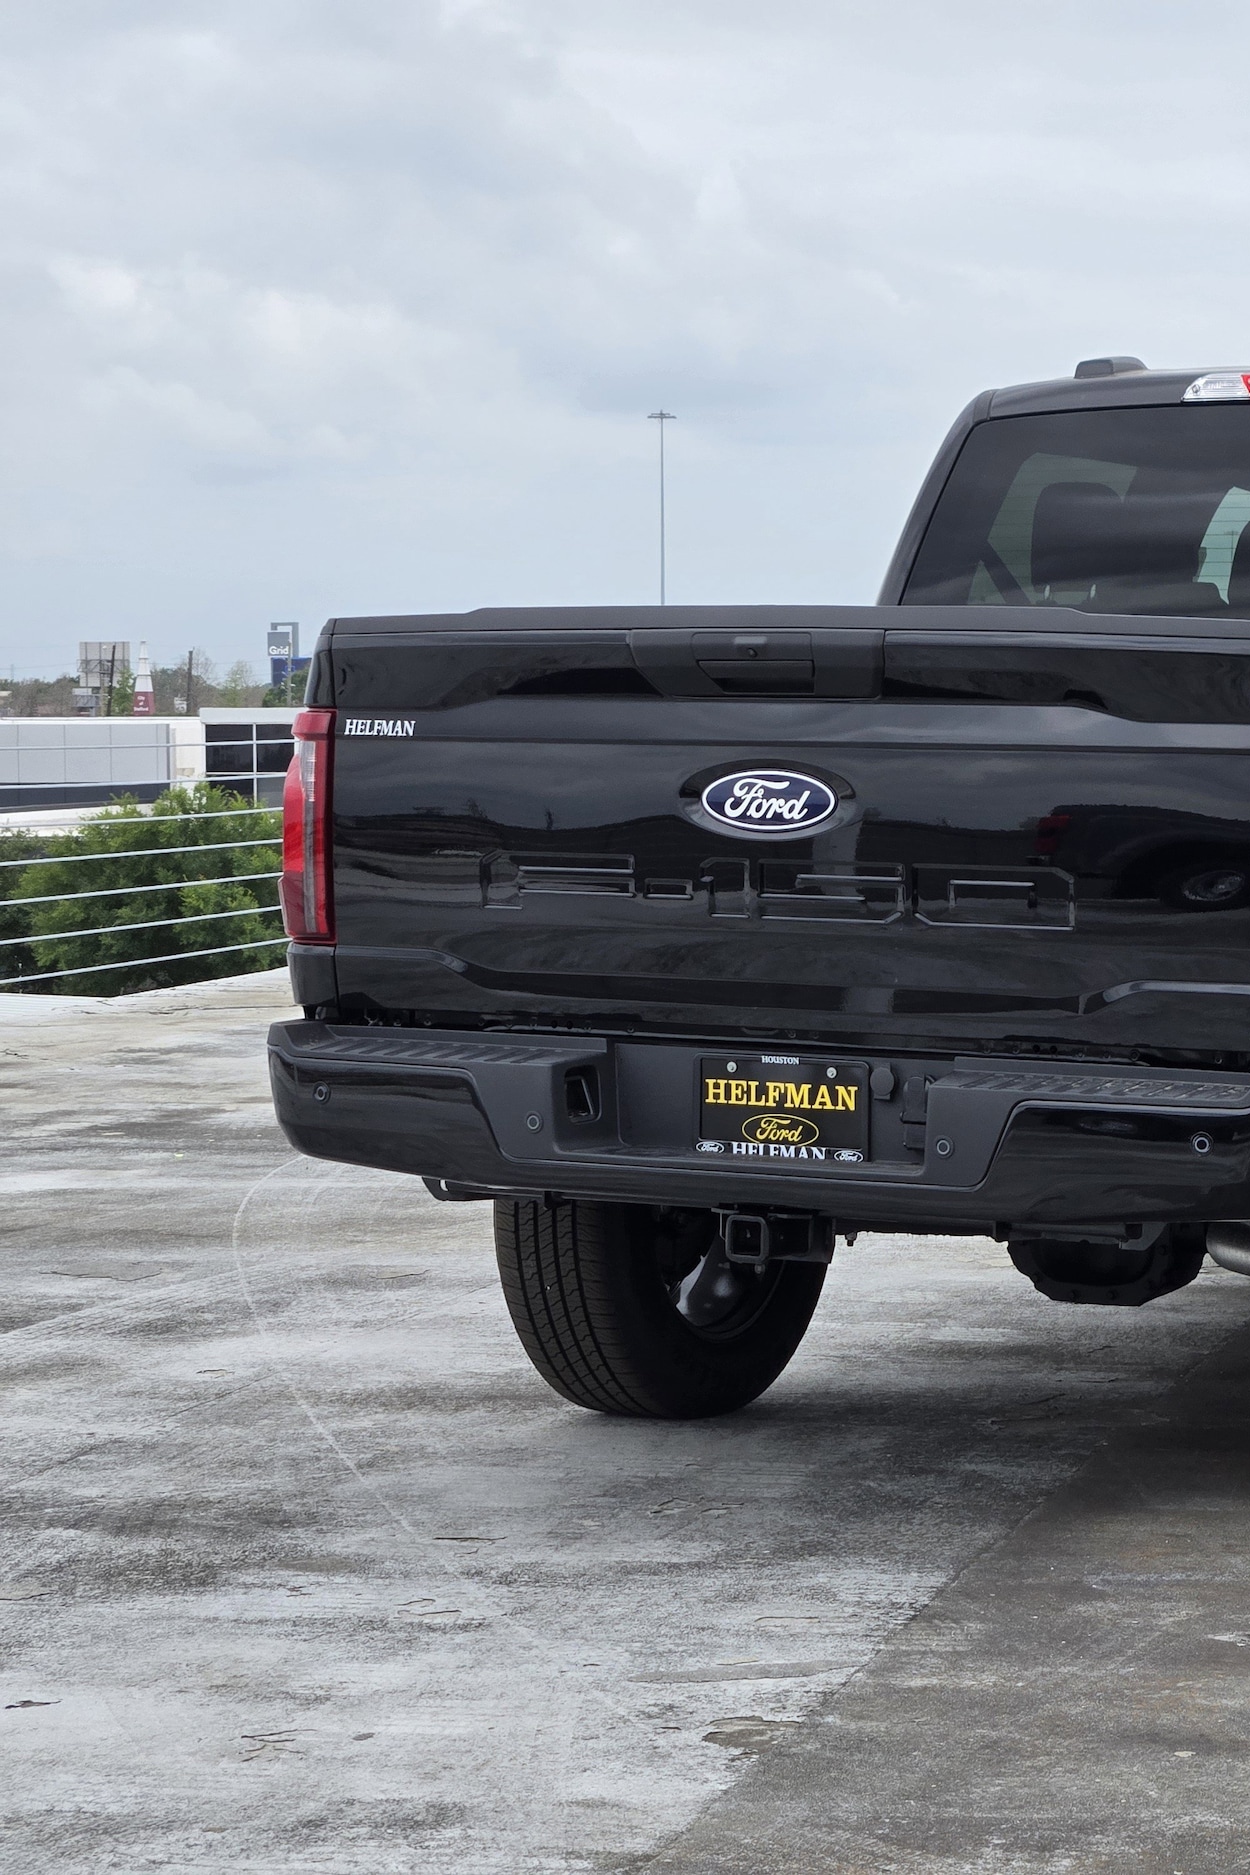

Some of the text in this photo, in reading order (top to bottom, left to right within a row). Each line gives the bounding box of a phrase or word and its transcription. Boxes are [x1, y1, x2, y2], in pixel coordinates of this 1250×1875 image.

[269, 645, 289, 655] Grid
[344, 718, 416, 737] HELFMAN
[724, 777, 811, 820] Ford
[761, 1055, 800, 1065] HOUSTON
[704, 1078, 858, 1112] HELFMAN
[755, 1116, 804, 1143] Ford
